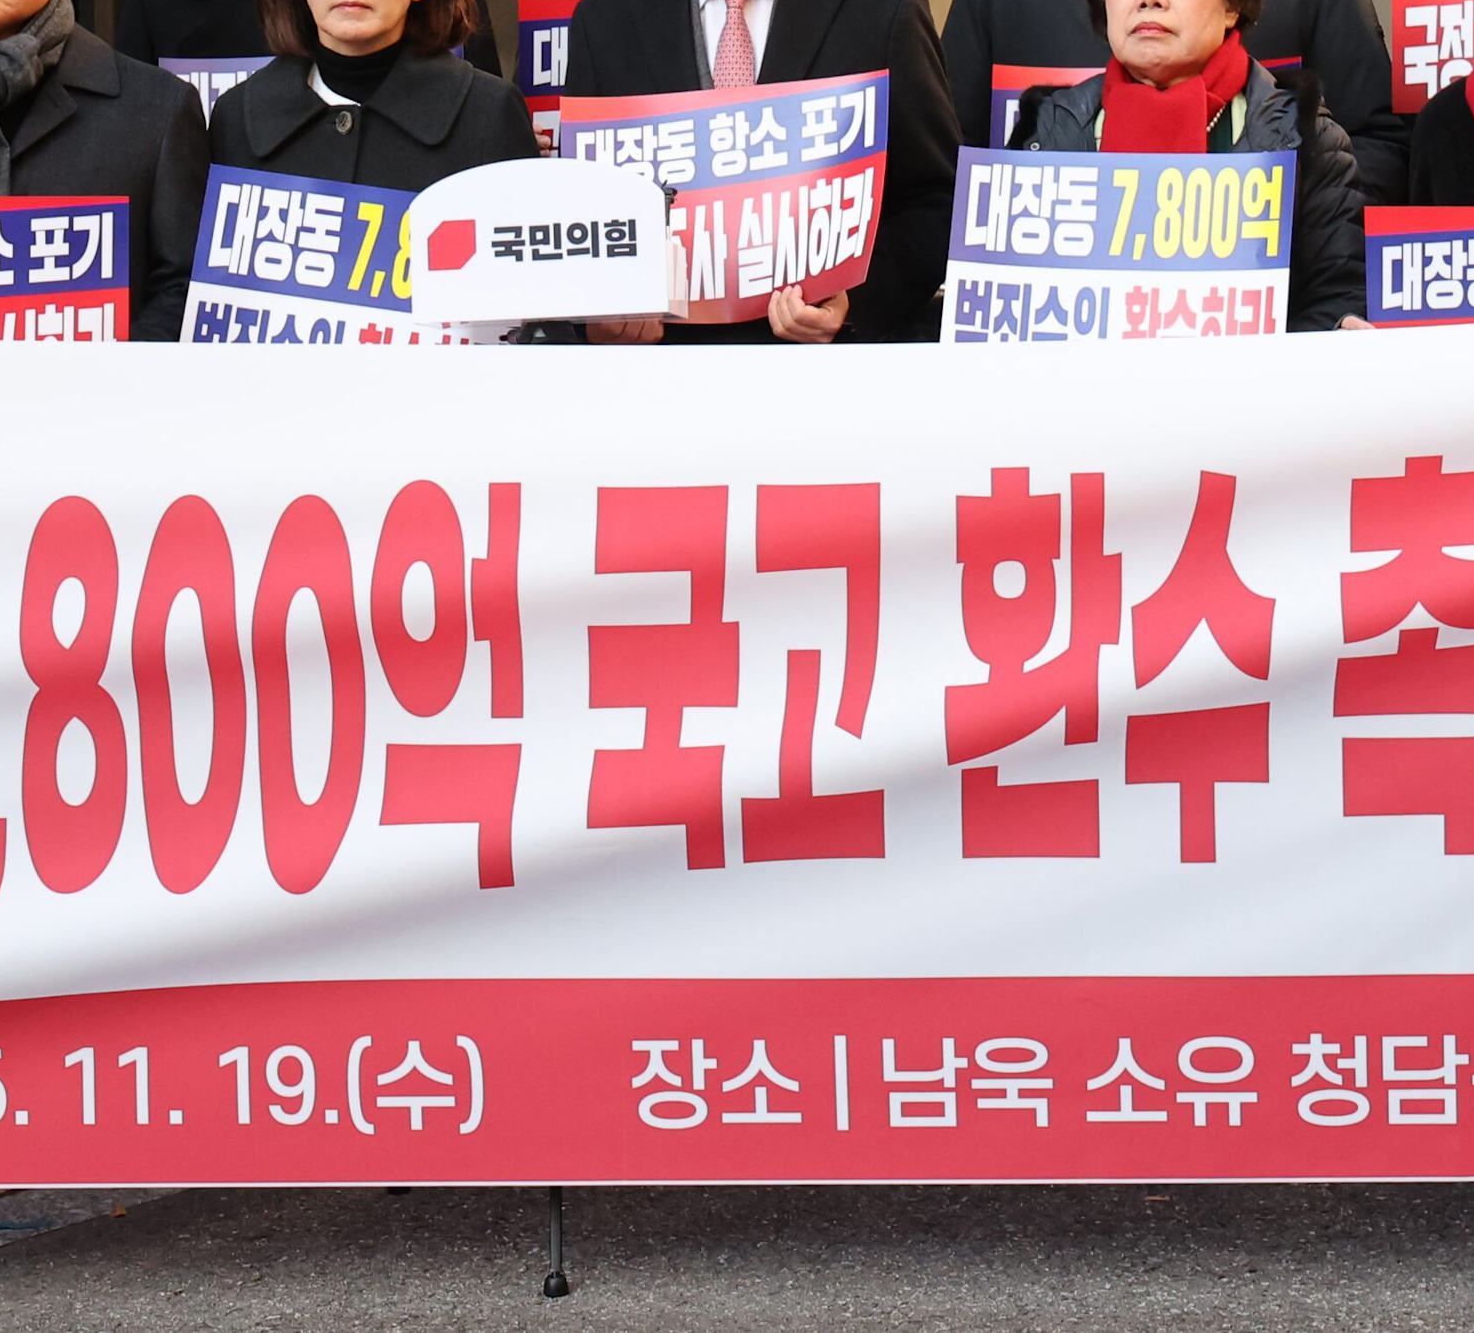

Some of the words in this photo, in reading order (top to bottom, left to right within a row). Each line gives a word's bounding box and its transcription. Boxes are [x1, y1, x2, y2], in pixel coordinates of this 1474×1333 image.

[709, 106, 789, 178] 항소
[800, 85, 876, 163] 포기
[28, 212, 114, 283] 포기
[207, 182, 345, 288] 대장동
[491, 218, 638, 262] 국민의힘
[737, 166, 874, 299] 실시하라
[964, 163, 1099, 257] 대장동
[1108, 165, 1283, 261] 7,800억
[586, 482, 886, 871] 국고
[944, 466, 1276, 863] 환수
[65, 1045, 183, 1125] 11.
[216, 1034, 485, 1135] 19.(수)
[630, 1036, 802, 1129] 장소
[880, 1035, 1055, 1128] 남욱
[1086, 1035, 1259, 1127] 소유
